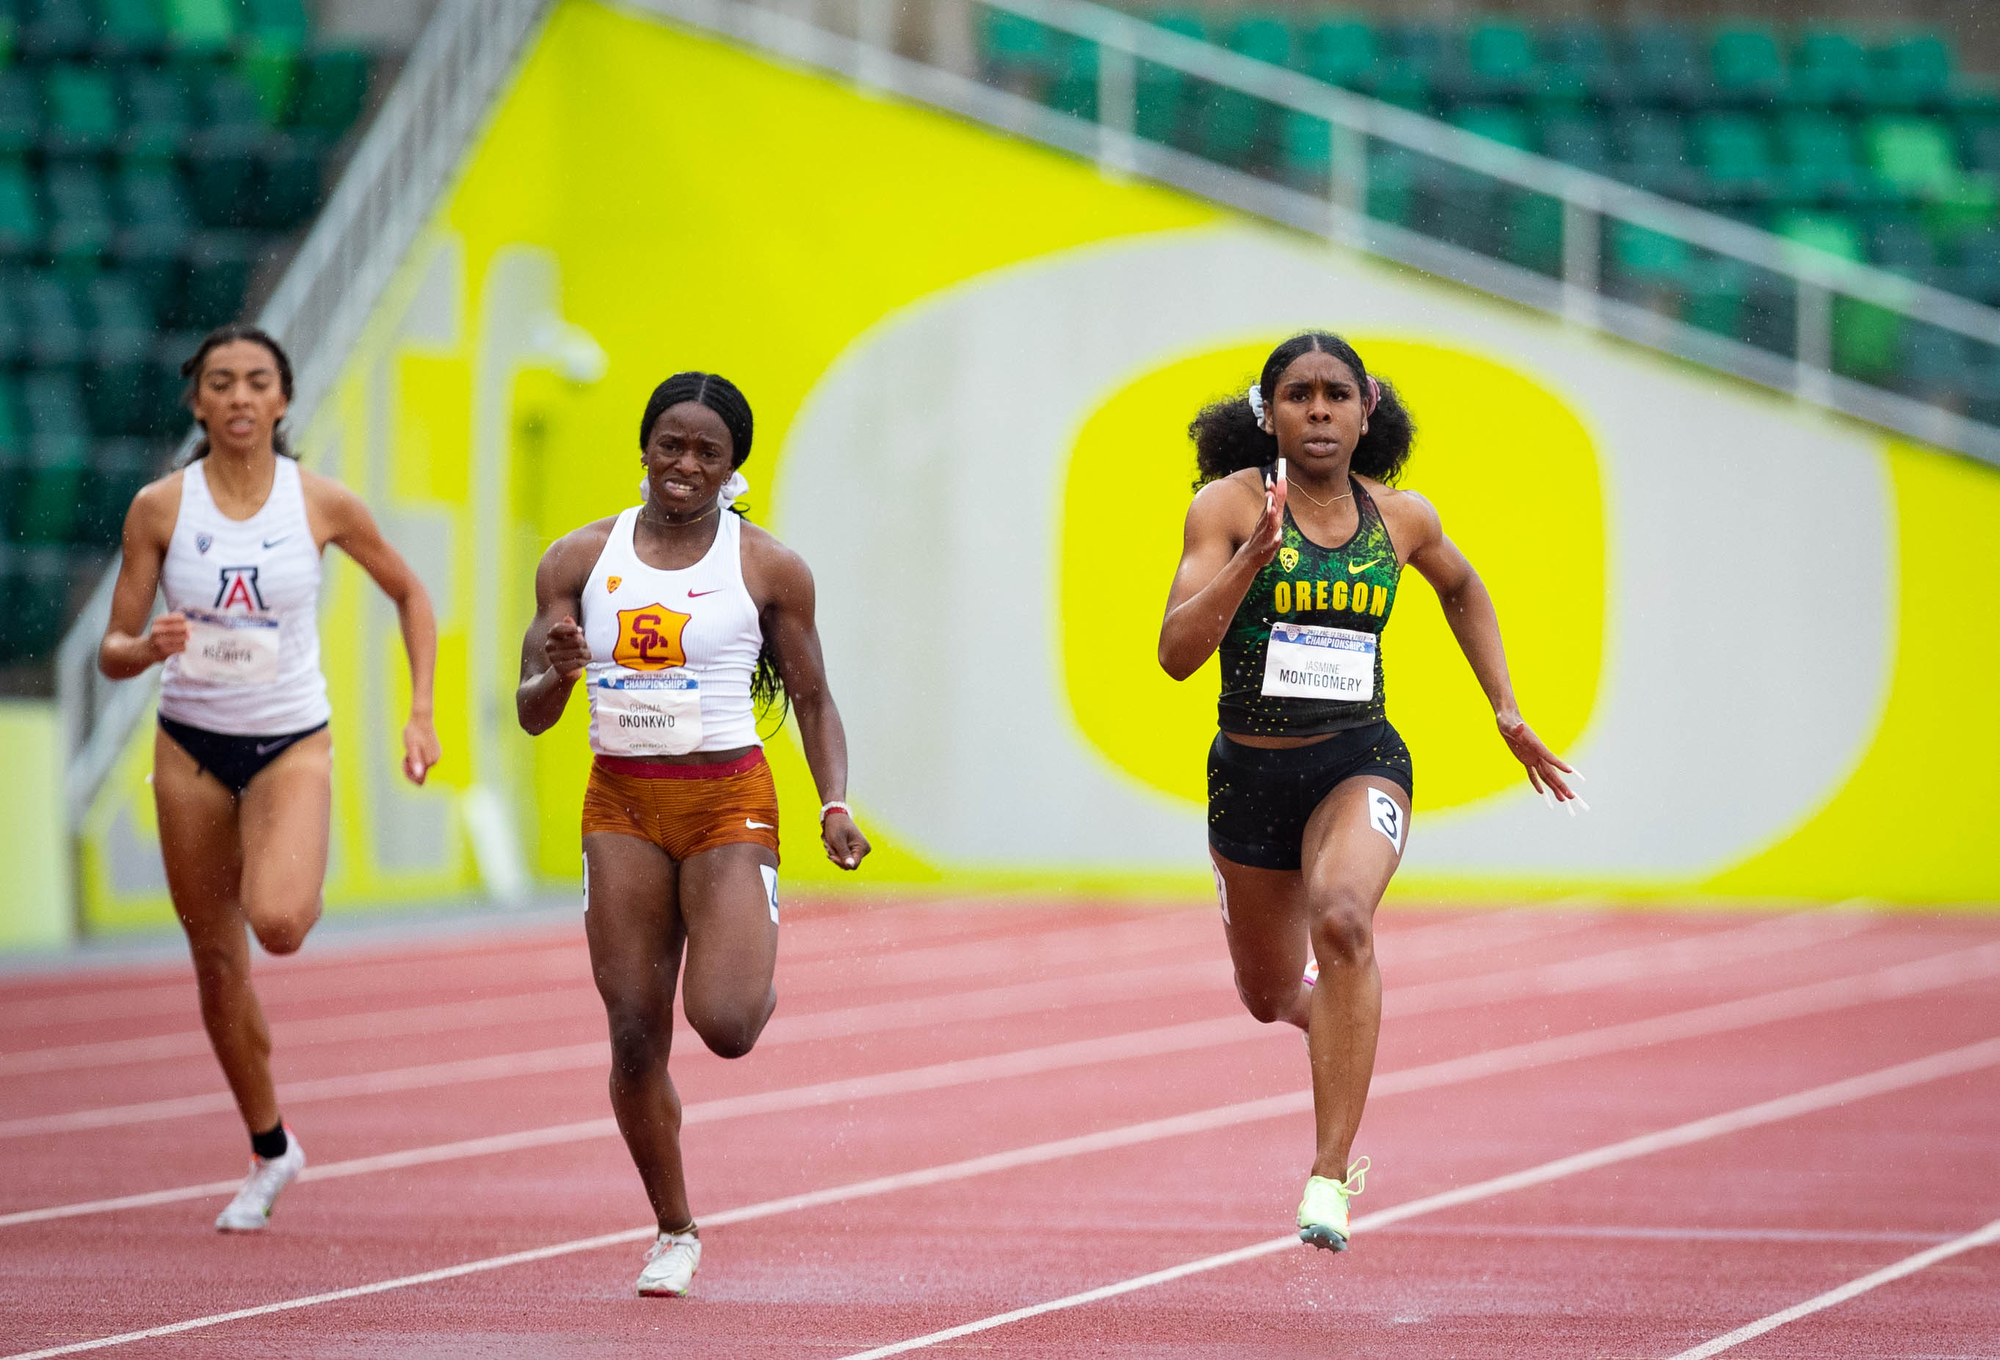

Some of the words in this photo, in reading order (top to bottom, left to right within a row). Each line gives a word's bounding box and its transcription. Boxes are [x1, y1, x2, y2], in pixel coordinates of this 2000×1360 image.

[215, 566, 270, 612] A
[1274, 580, 1388, 617] OREGON
[630, 614, 668, 664] SC
[1305, 635, 1365, 652] CHAMPIONSHIPS
[1305, 661, 1340, 674] JASMINE
[624, 679, 687, 689] CHAMPIONSHIPS
[1280, 669, 1362, 692] MONTGOMERY
[618, 714, 675, 728] OKONKWO
[1376, 796, 1398, 840] 3
